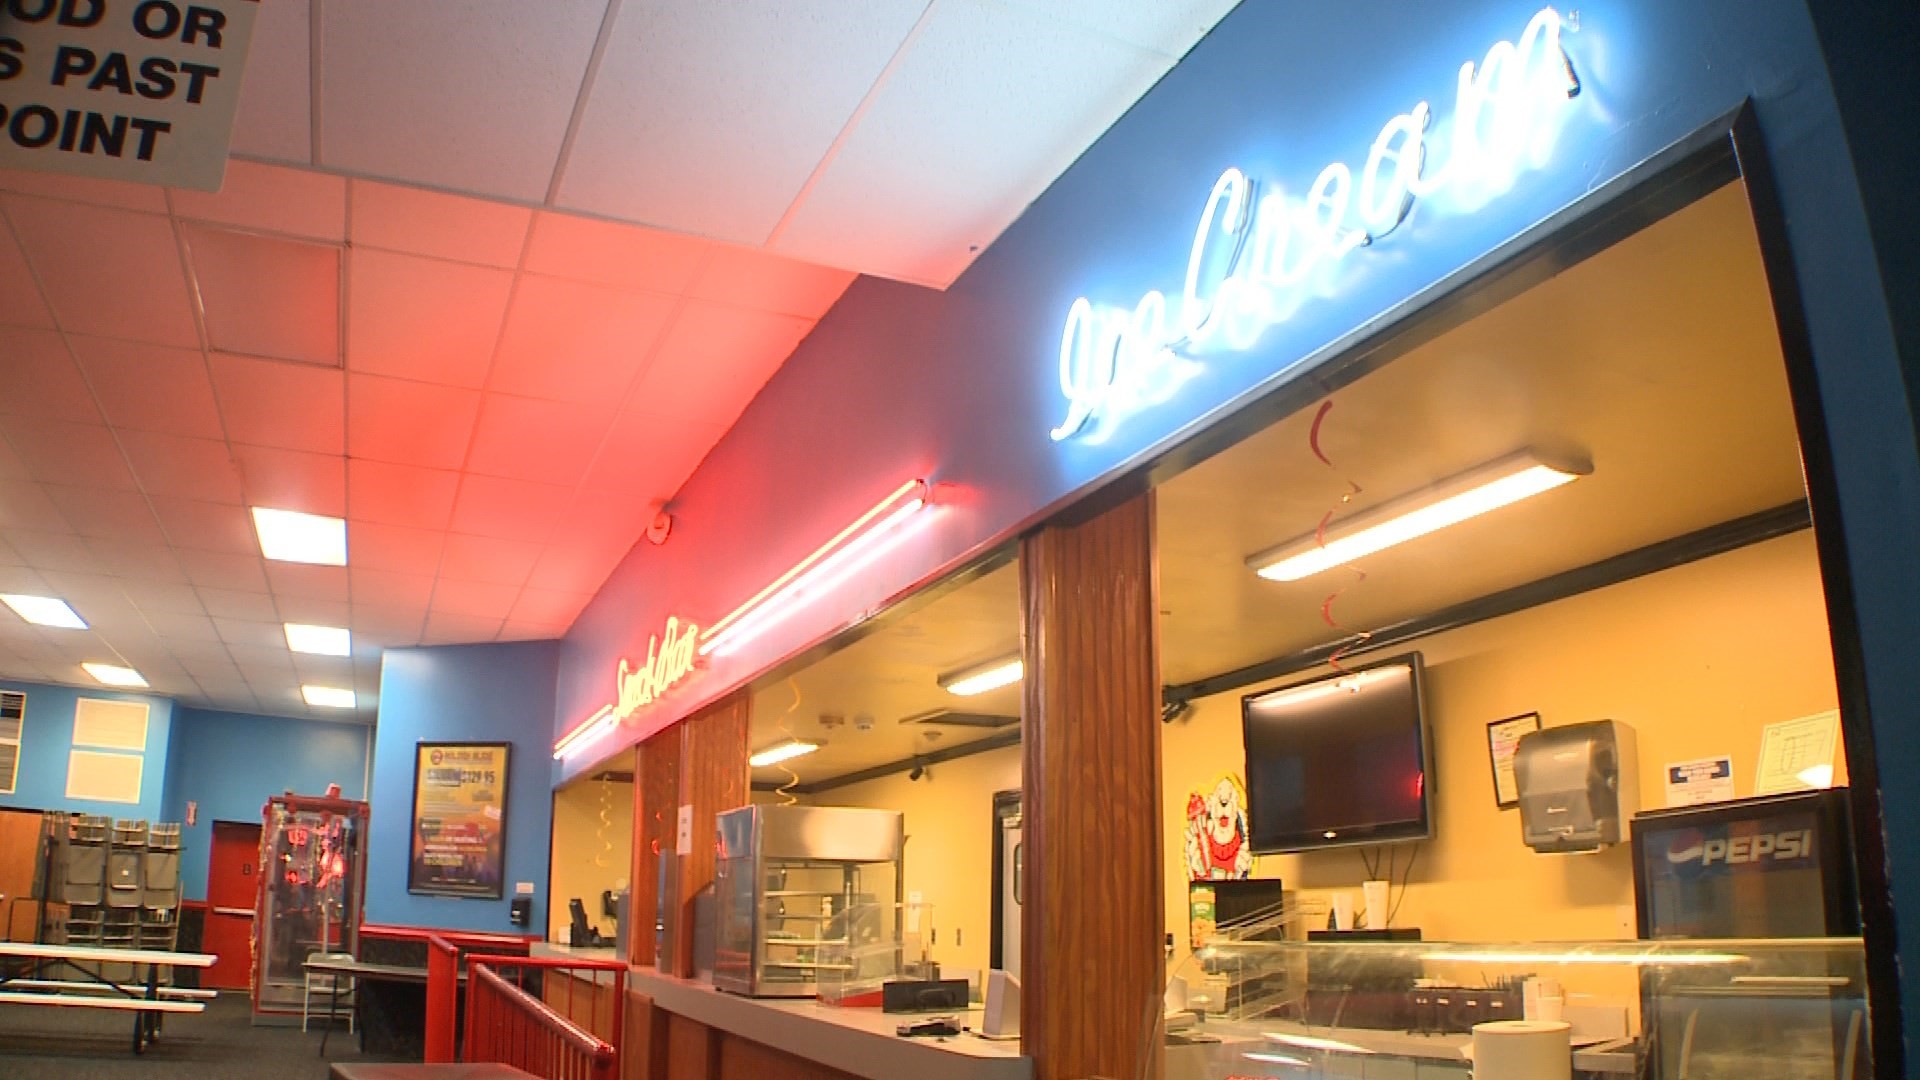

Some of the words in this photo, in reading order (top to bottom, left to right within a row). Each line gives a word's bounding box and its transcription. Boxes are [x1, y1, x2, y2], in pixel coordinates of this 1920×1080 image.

[133, 0, 226, 49] OR
[51, 46, 220, 104] PAST
[0, 104, 172, 161] OINT
[1050, 290, 1177, 442] Ice
[1182, 6, 1581, 338] Cream
[653, 616, 699, 698] Bar
[1703, 829, 1812, 866] PEPSI
